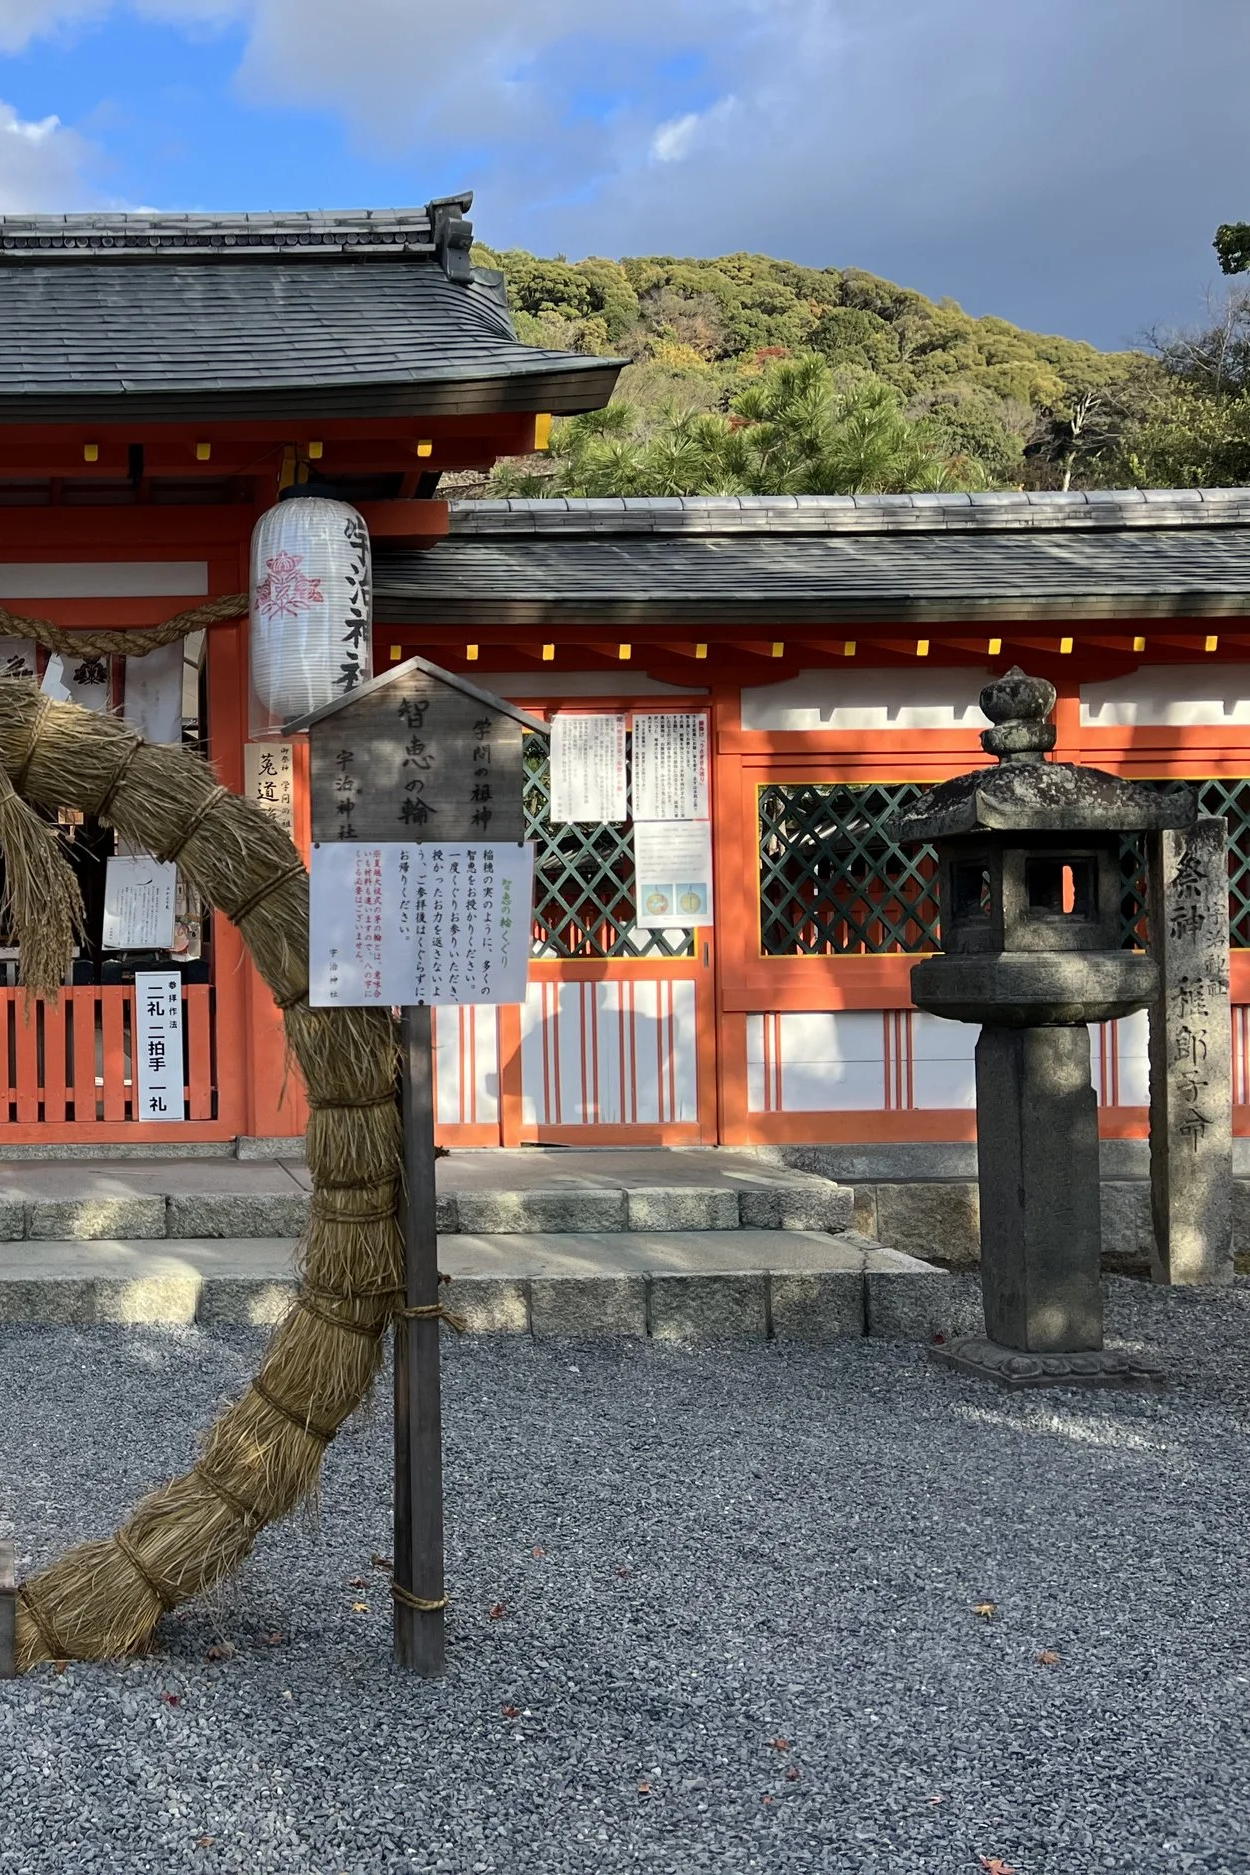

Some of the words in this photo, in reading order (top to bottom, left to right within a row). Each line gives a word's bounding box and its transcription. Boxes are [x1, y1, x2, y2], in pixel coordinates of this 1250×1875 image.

[336, 750, 359, 840] 宇治神社
[396, 697, 437, 826] 智恵の輪
[470, 717, 494, 832] 学問の祖神
[399, 850, 410, 941] お帰りください。
[431, 849, 444, 997] 授かったお力を返さないよ
[449, 852, 461, 1002] 一度くぐりお参りいただき、
[465, 849, 478, 990] 智恵をお授かりください。
[481, 849, 495, 995] 稲穂の実のように、多くの
[1171, 853, 1209, 946] 祭神
[1205, 901, 1228, 997] 宇治神社
[147, 986, 165, 1017] 二礼
[168, 981, 178, 1029] 参拝作法
[147, 1026, 166, 1072] 二拍手
[149, 1086, 167, 1112] 一礼
